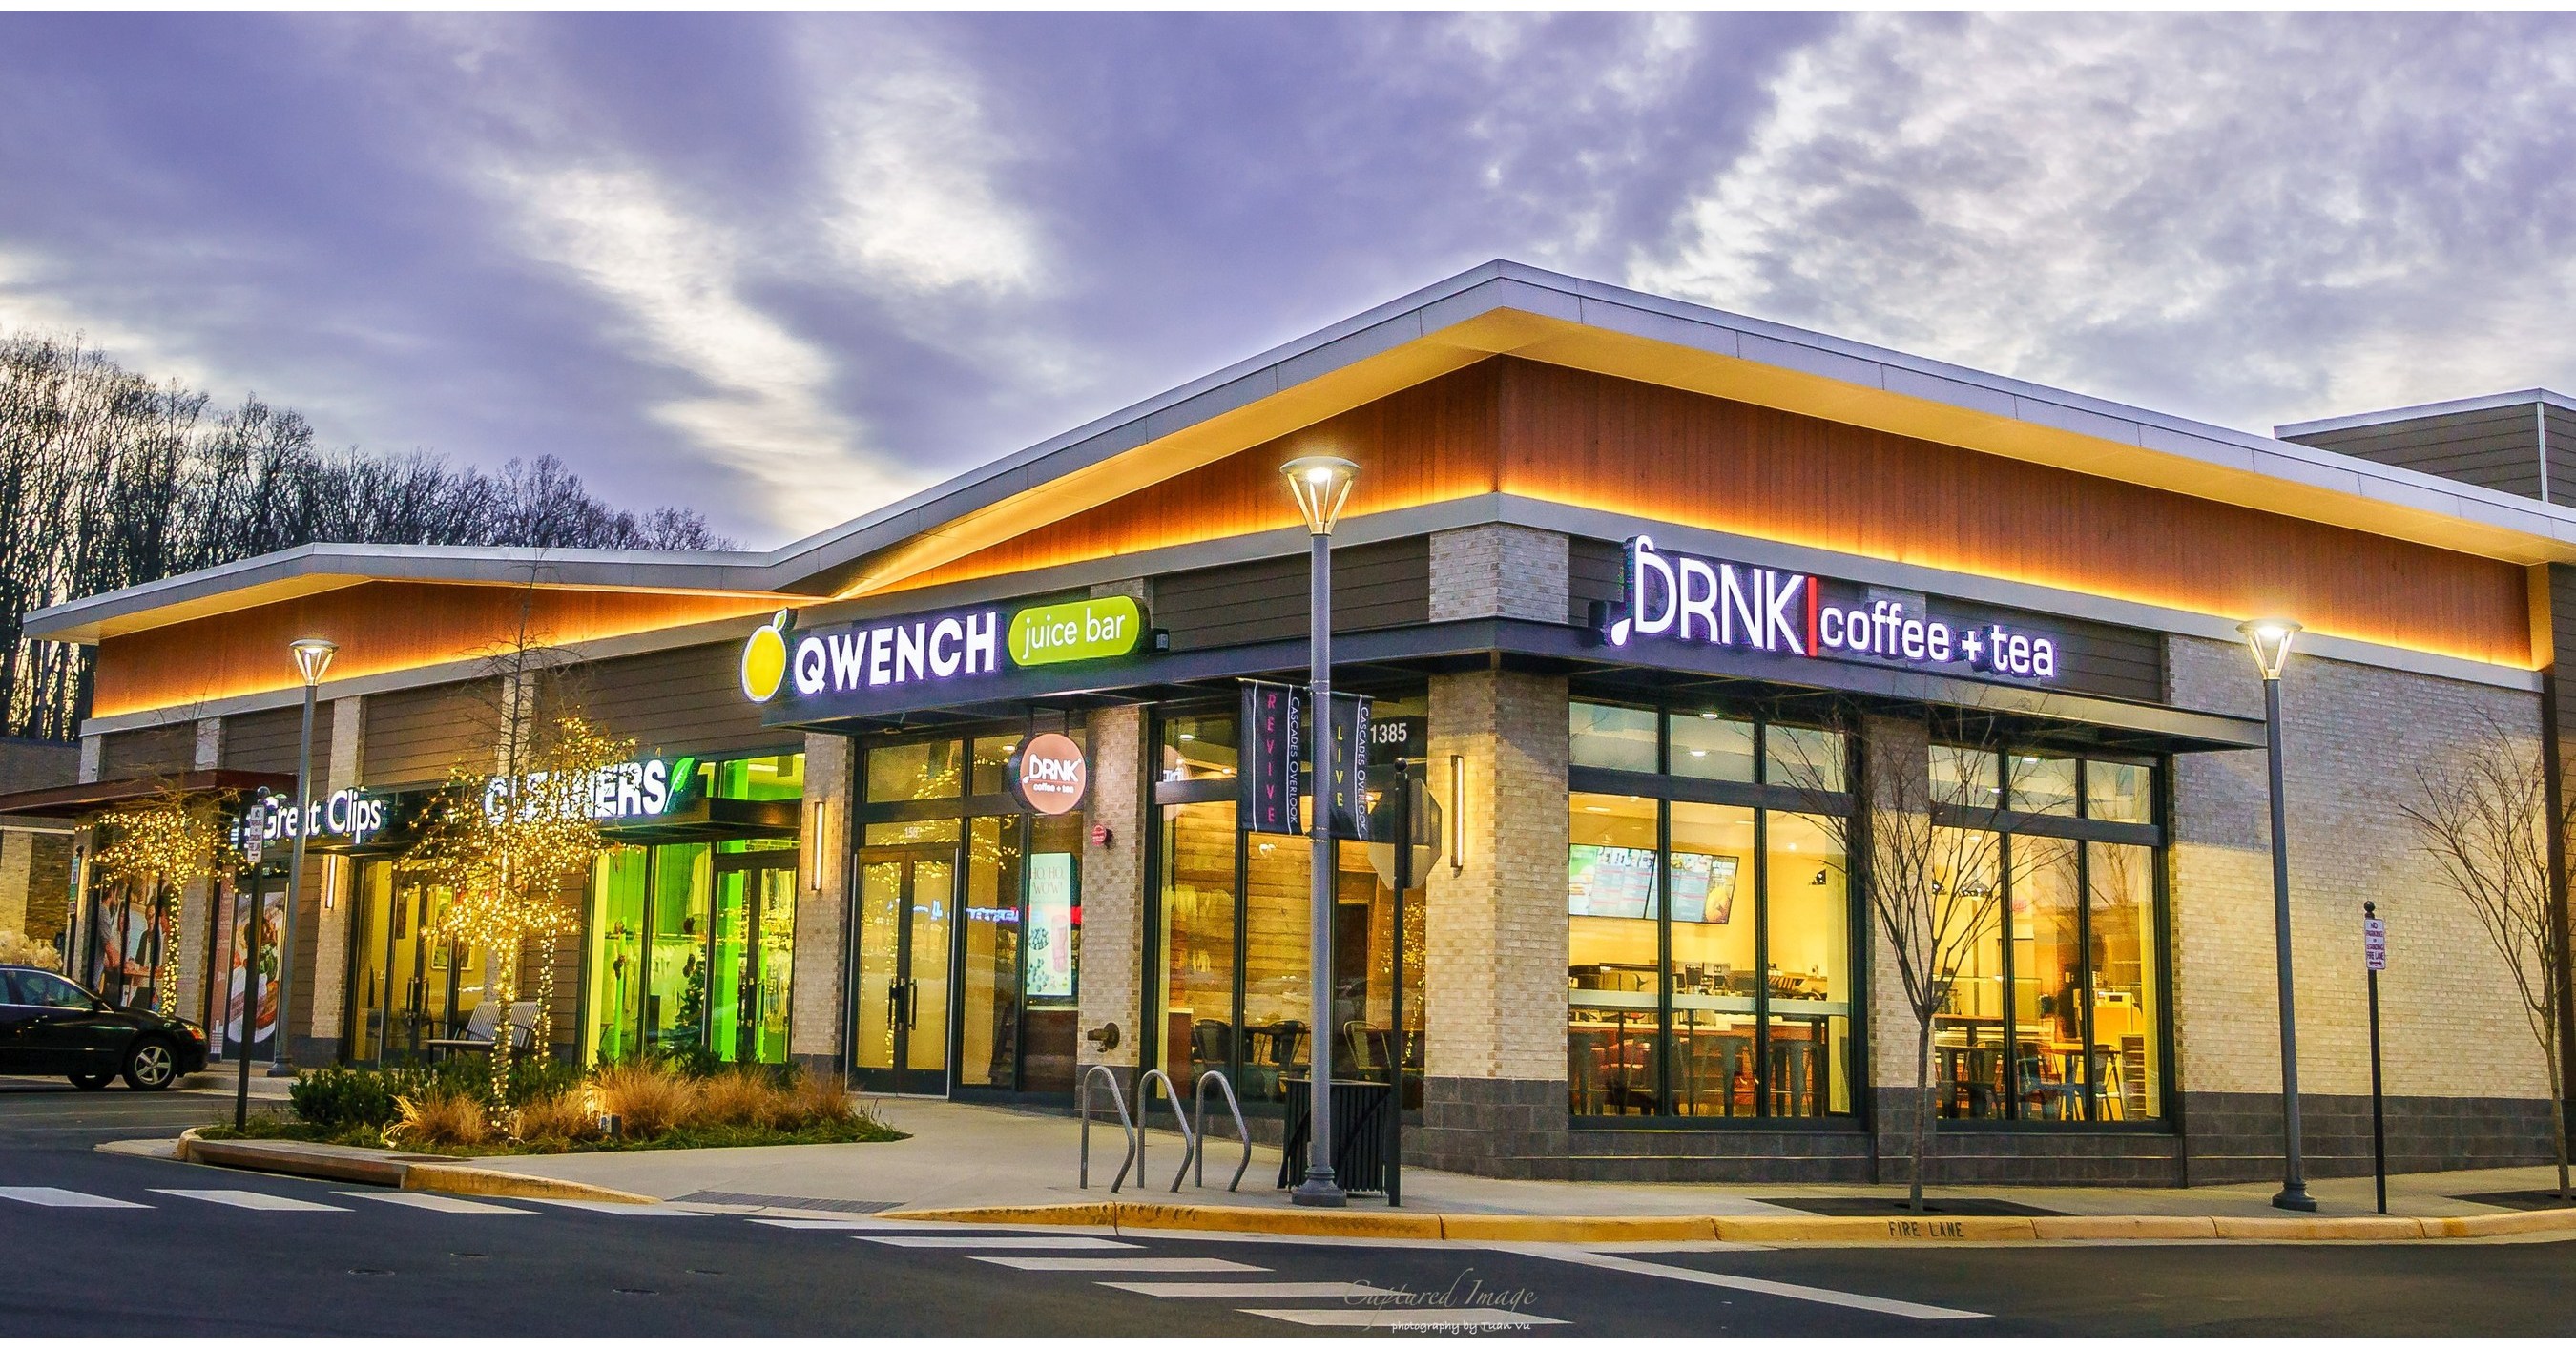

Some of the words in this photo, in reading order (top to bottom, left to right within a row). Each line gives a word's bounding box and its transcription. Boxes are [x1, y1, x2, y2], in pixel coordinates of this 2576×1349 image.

[1610, 535, 1805, 655] DRNK
[795, 612, 997, 695] QWENCH
[1022, 613, 1078, 659] juice
[1086, 608, 1127, 641] bar
[1820, 601, 1951, 659] coffee
[1991, 625, 2055, 676] tea
[1266, 694, 1277, 822] REVIVE
[1290, 696, 1300, 758] CASCADES
[1358, 707, 1369, 766] CASCADES
[1370, 723, 1407, 744] 1385
[1023, 754, 1082, 784] DRNK
[1289, 760, 1299, 823] OVERLOOK
[263, 795, 322, 840] Gret
[328, 789, 382, 844] Clips
[1357, 769, 1368, 832] OVERLOOK
[1888, 1221, 1921, 1237] FIRE
[1928, 1221, 1964, 1238] LANE
